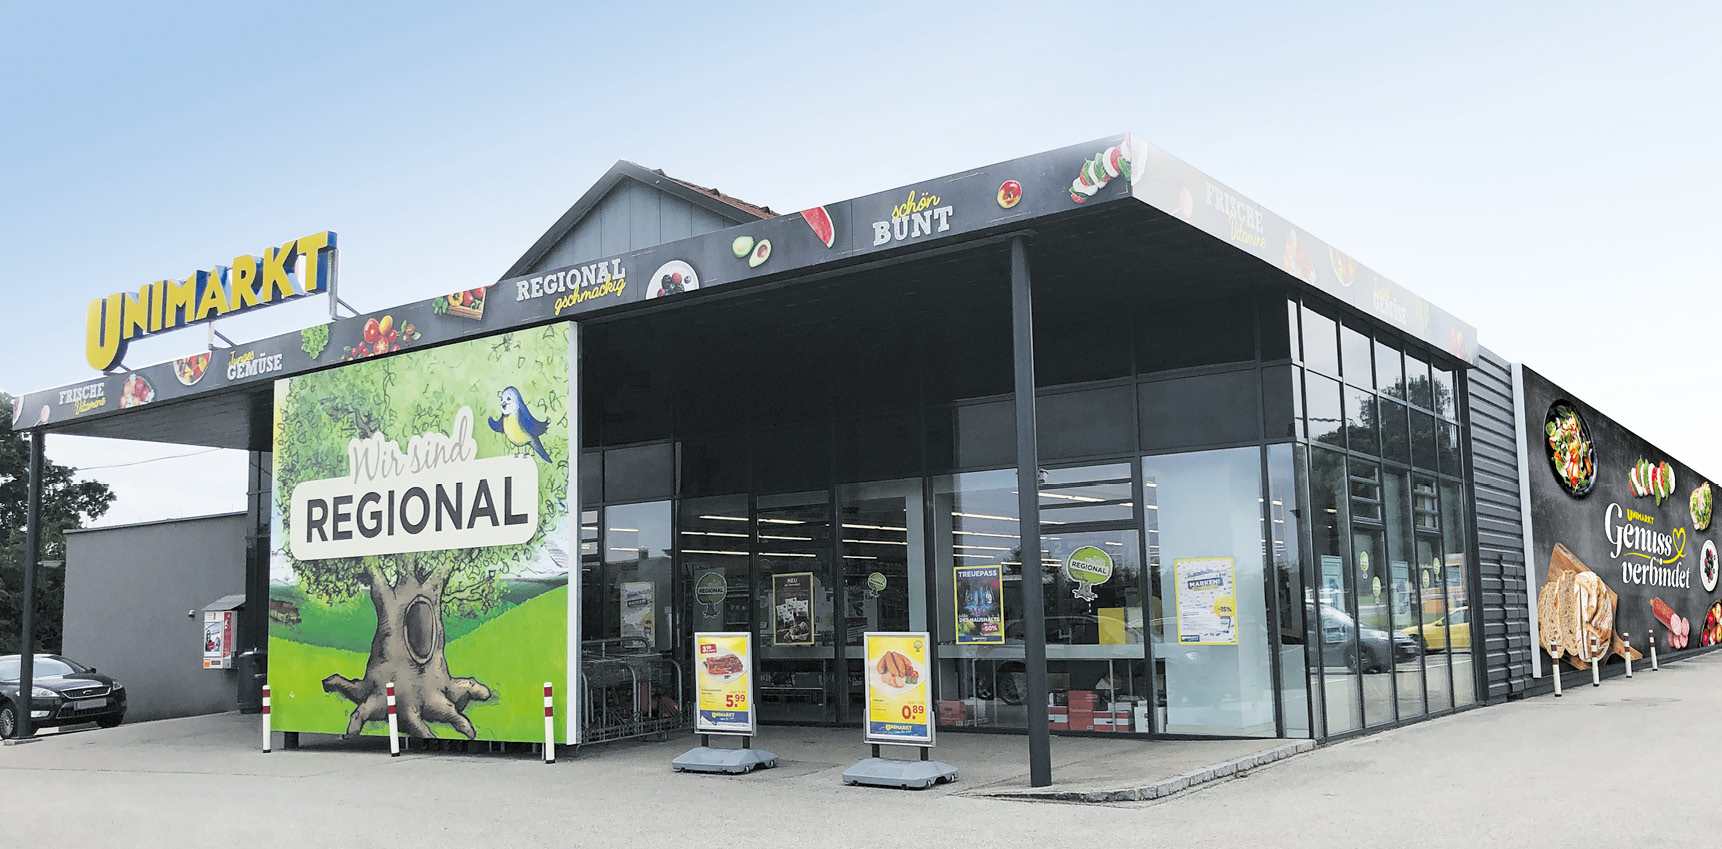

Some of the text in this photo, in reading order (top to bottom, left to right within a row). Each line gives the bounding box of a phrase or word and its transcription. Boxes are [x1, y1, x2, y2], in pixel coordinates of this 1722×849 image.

[891, 189, 941, 219] schön
[1205, 181, 1264, 235] FRISCHE
[872, 205, 954, 246] BUNT
[515, 258, 626, 302] REGIONAL
[86, 231, 337, 371] UNIMARKT
[226, 352, 283, 381] GEMÜSE
[58, 382, 105, 405] FRISCHE
[353, 414, 473, 485] Wir sind
[306, 476, 529, 543] REGIONAL
[1626, 508, 1655, 525] UNIMARKT
[1604, 502, 1673, 559] Genuss
[958, 569, 998, 578] TREUEPASS
[1071, 561, 1107, 575] REGIONAL
[1621, 556, 1691, 589] verbindet
[725, 694, 746, 708] 5.99
[901, 704, 924, 720] 0.89
